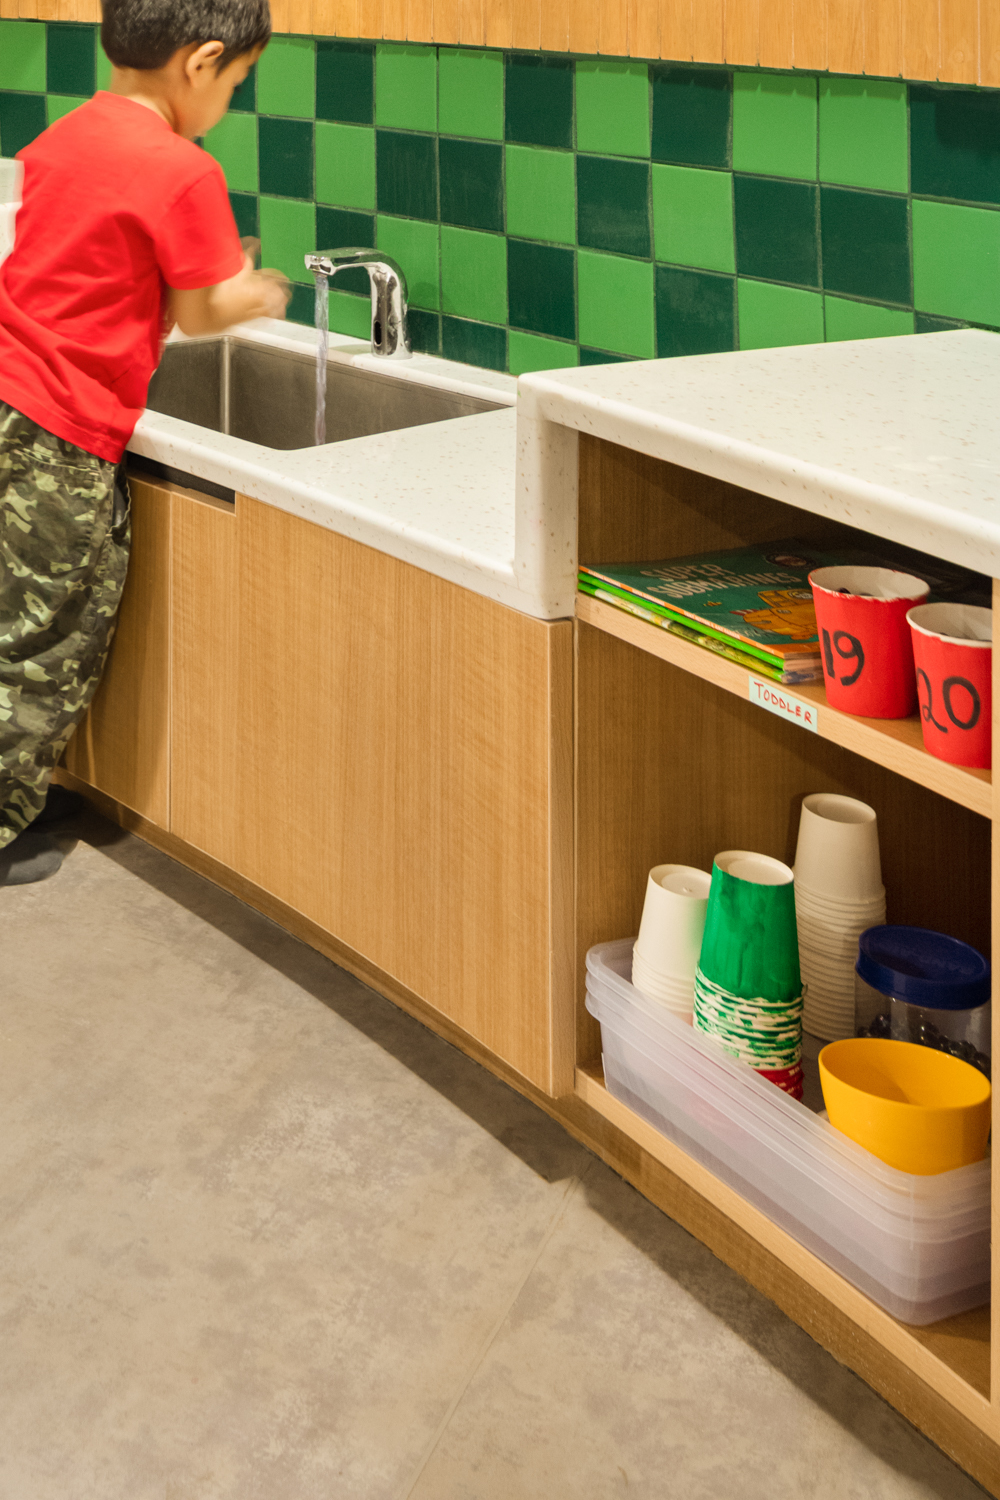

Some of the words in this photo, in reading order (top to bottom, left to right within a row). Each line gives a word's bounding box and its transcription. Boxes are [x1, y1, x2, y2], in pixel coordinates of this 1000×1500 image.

[640, 563, 736, 582] SUPER
[646, 572, 803, 599] SUBMARINES
[821, 627, 866, 687] 19
[753, 681, 813, 726] TODDLER
[915, 667, 981, 733] 20
